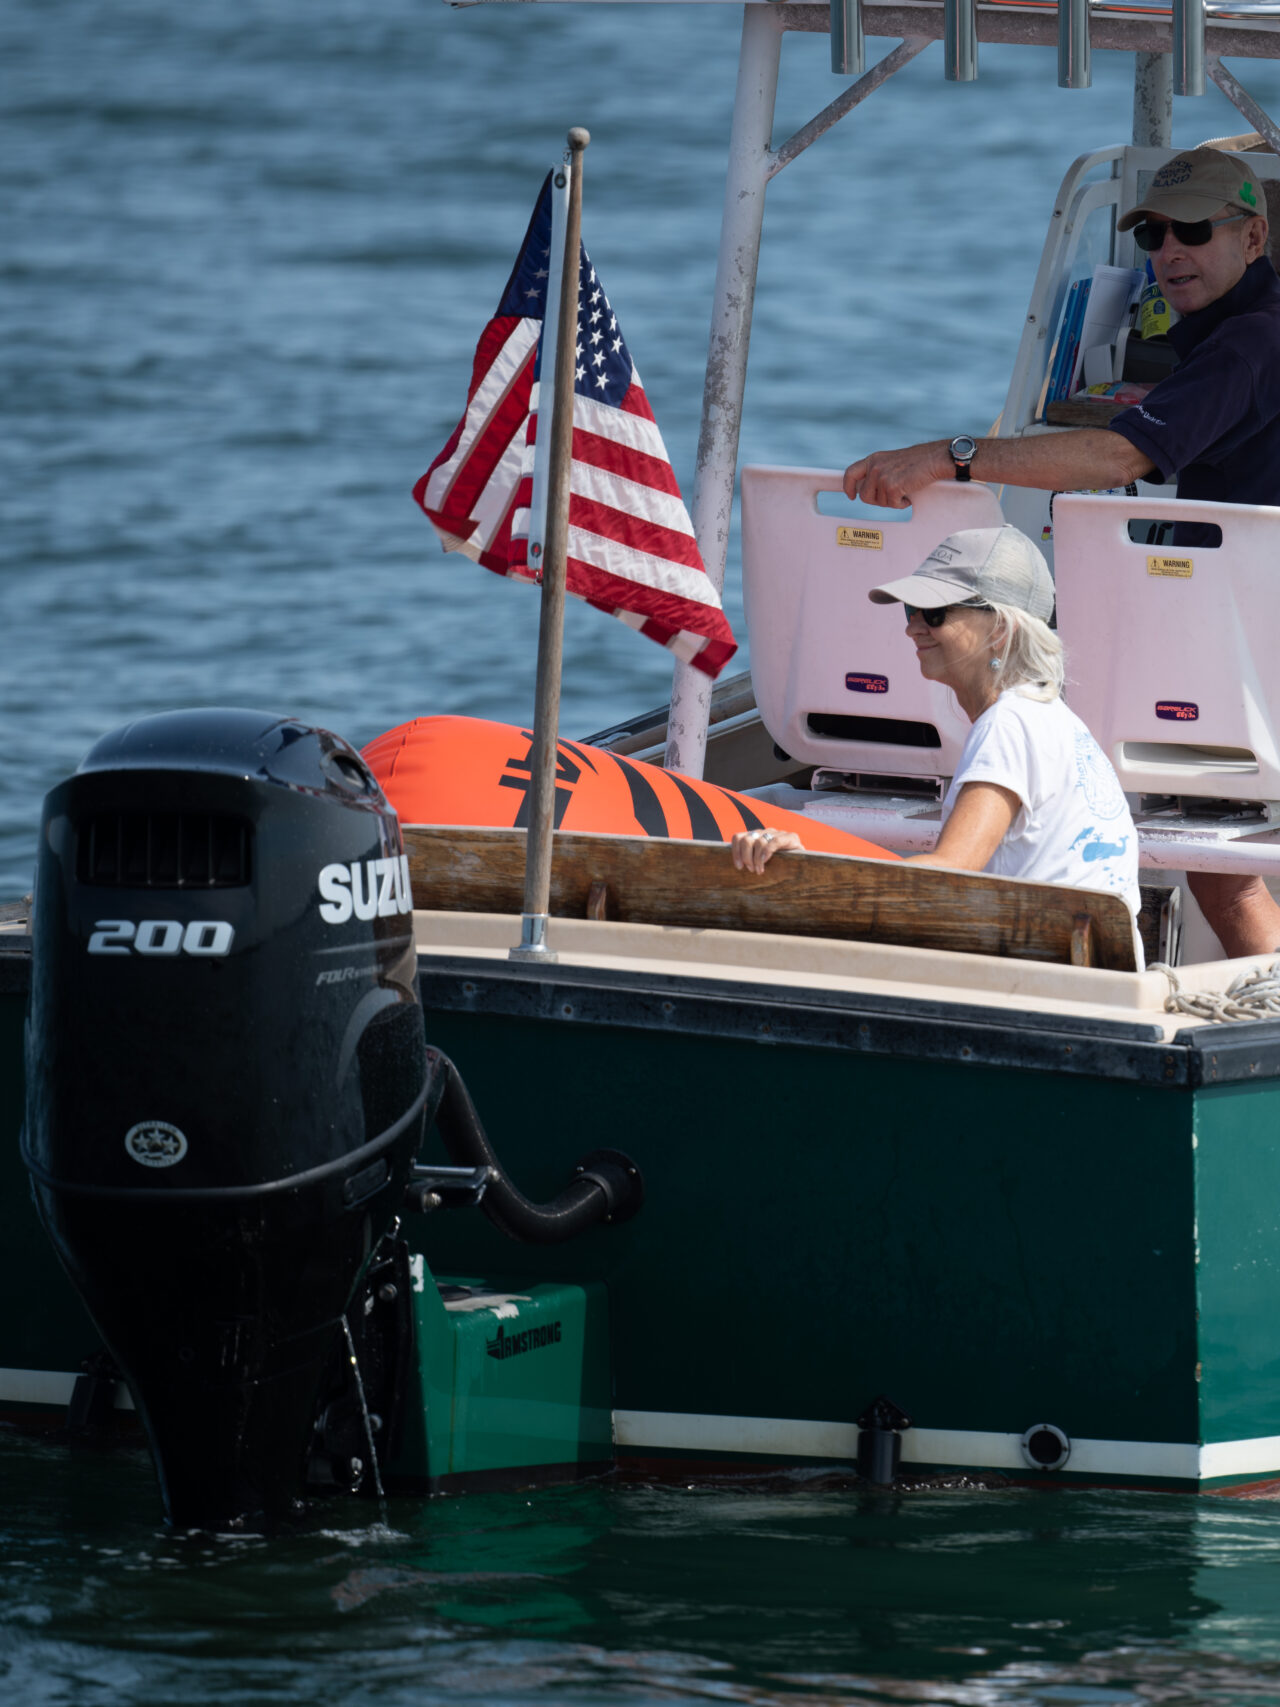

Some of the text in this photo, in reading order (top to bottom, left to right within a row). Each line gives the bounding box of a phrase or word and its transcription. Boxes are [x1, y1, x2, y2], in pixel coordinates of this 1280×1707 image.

[853, 530, 880, 540] WARNING
[1162, 559, 1190, 568] WARNING
[87, 920, 235, 957] 200
[486, 1321, 562, 1360] ARMSTRONG
